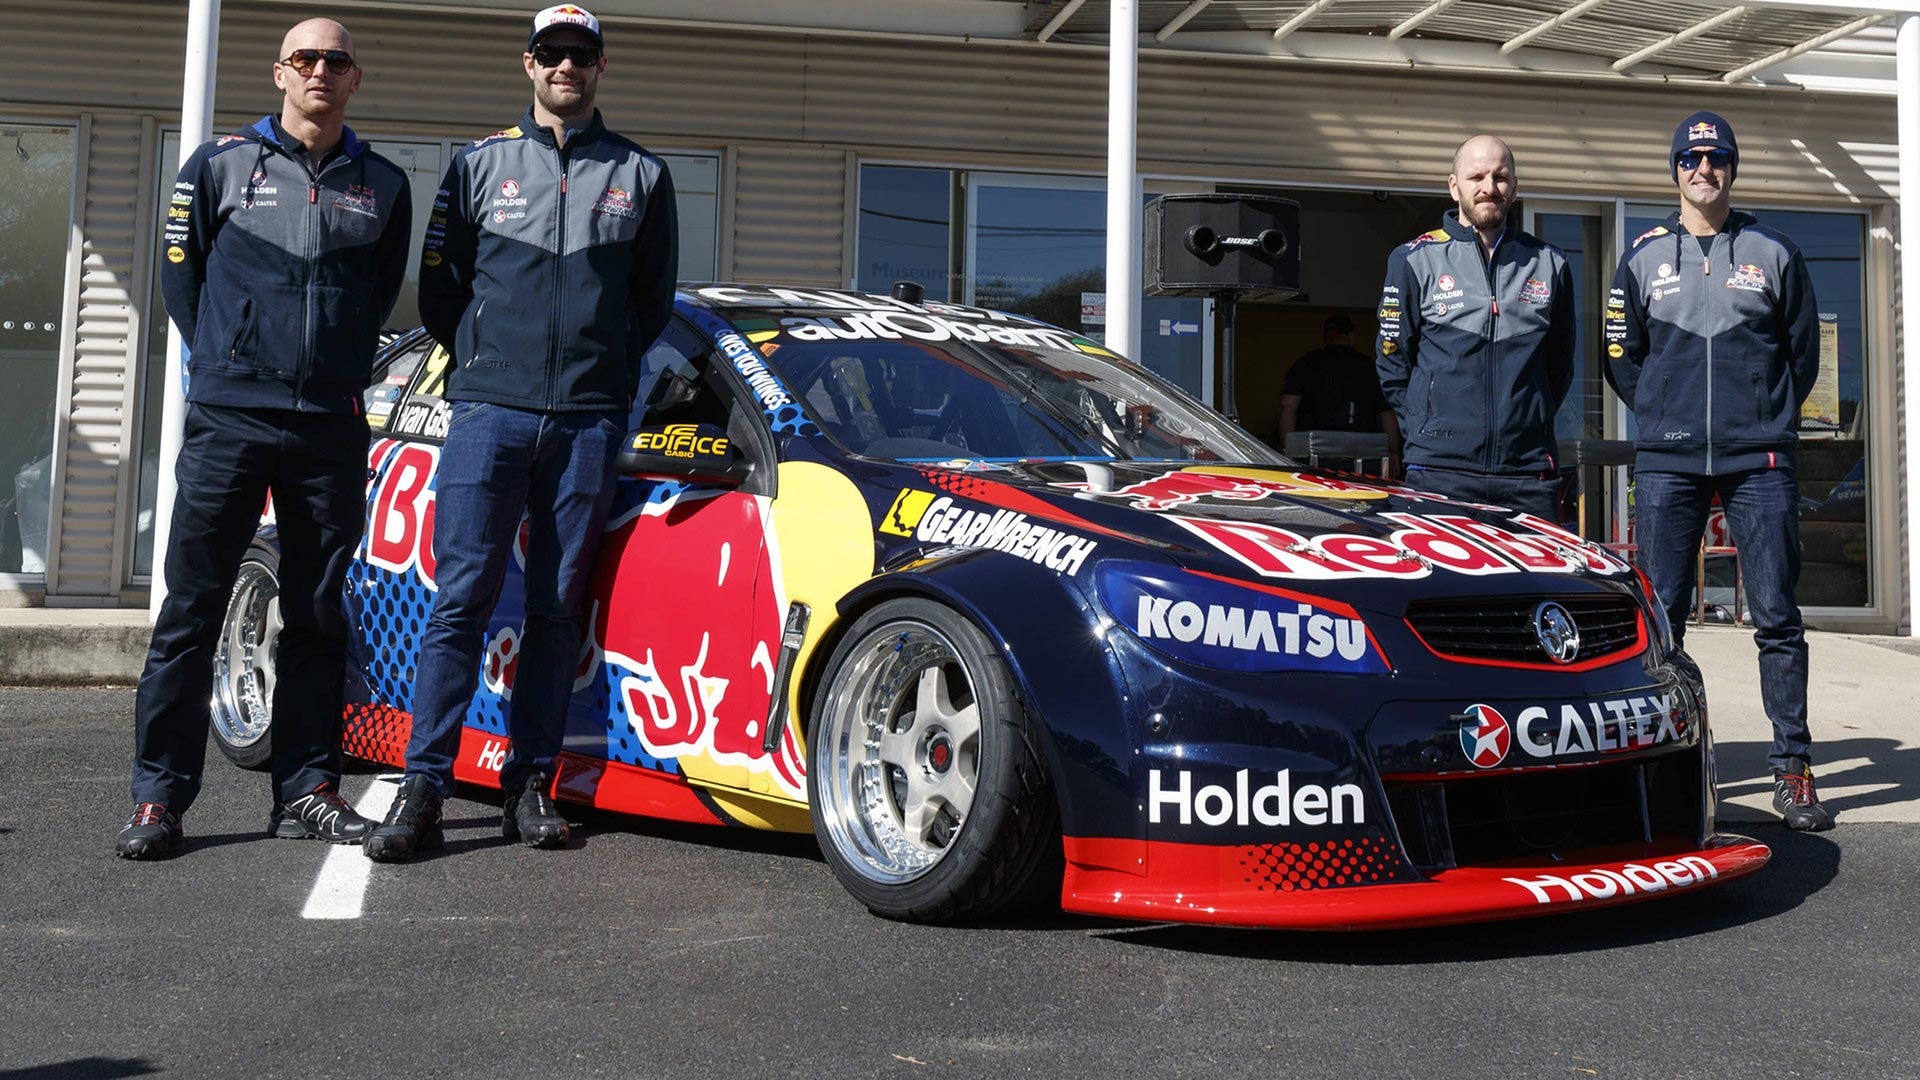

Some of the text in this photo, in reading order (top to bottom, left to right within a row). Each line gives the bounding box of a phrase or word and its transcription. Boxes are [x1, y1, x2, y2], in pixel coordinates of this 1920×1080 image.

[241, 186, 277, 195] HOLDEN
[493, 198, 527, 207] HOLDEN
[506, 212, 526, 220] CALTEX
[1221, 237, 1258, 245] BOSE
[1433, 289, 1463, 301] HOLDEN
[715, 329, 750, 356] GIVES
[733, 352, 766, 376] YOU
[748, 371, 791, 411] WINGS
[398, 403, 430, 434] van
[632, 433, 729, 455] EDIFICE
[664, 450, 695, 459] CASIO
[1137, 595, 1367, 661] KOMATSU
[1516, 694, 1681, 758] CALTEX
[477, 739, 506, 772] Ho
[1149, 768, 1365, 826] Holden
[1501, 856, 1718, 904] Holden
